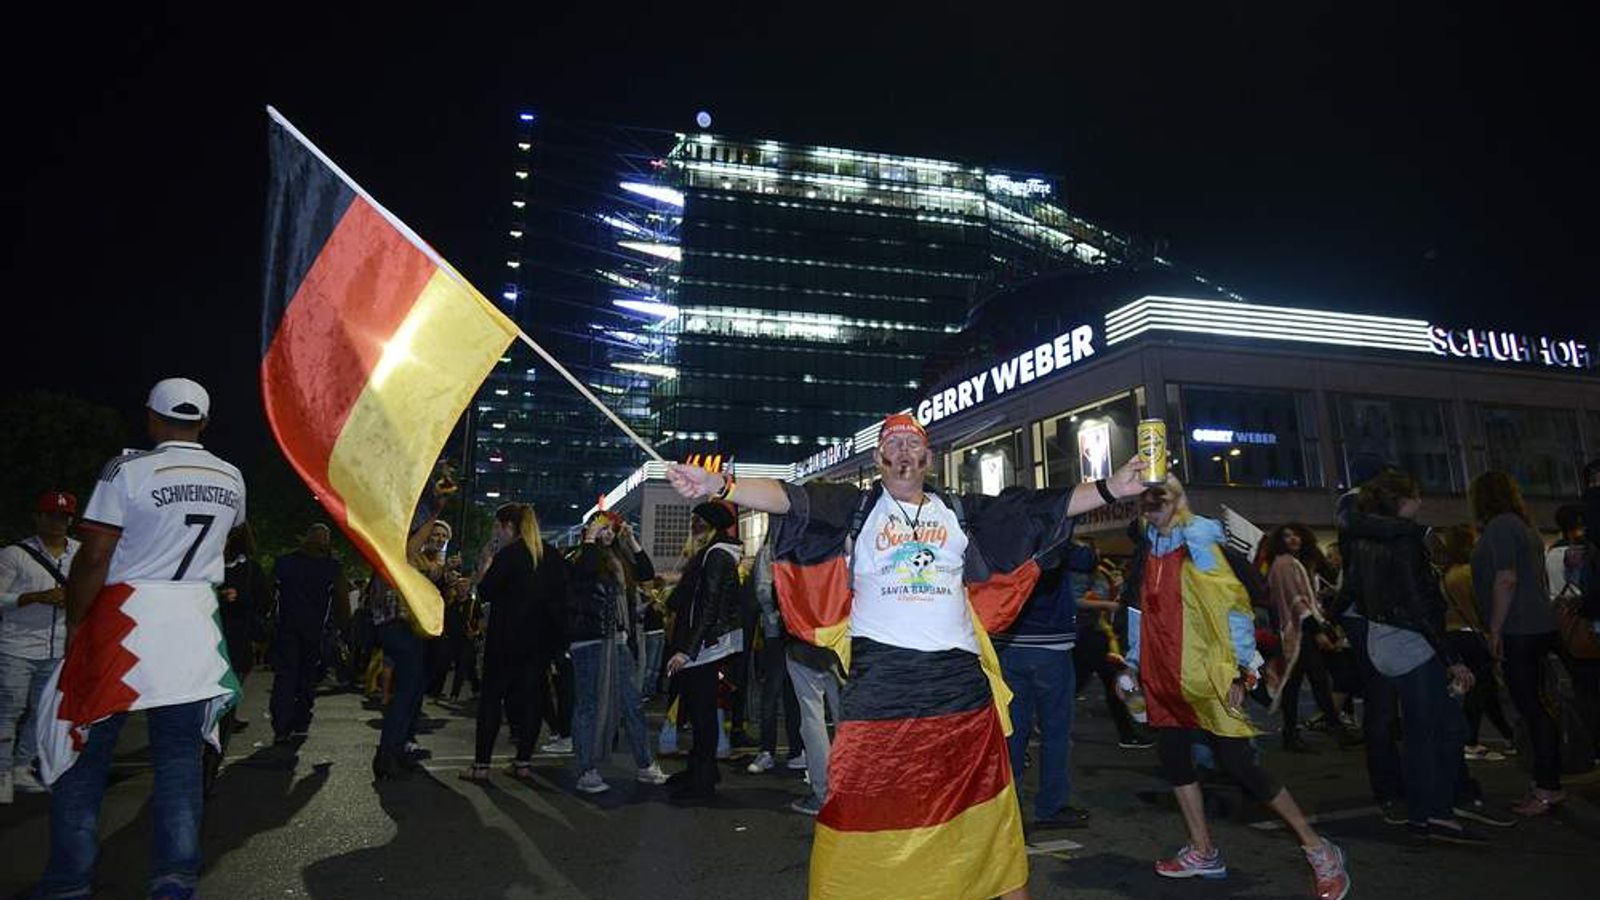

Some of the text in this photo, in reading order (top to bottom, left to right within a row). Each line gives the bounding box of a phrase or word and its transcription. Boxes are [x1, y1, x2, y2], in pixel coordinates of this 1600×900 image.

[916, 324, 1095, 427] GERRY WEBER
[170, 513, 217, 581] 7
[881, 585, 909, 596] SANTA
